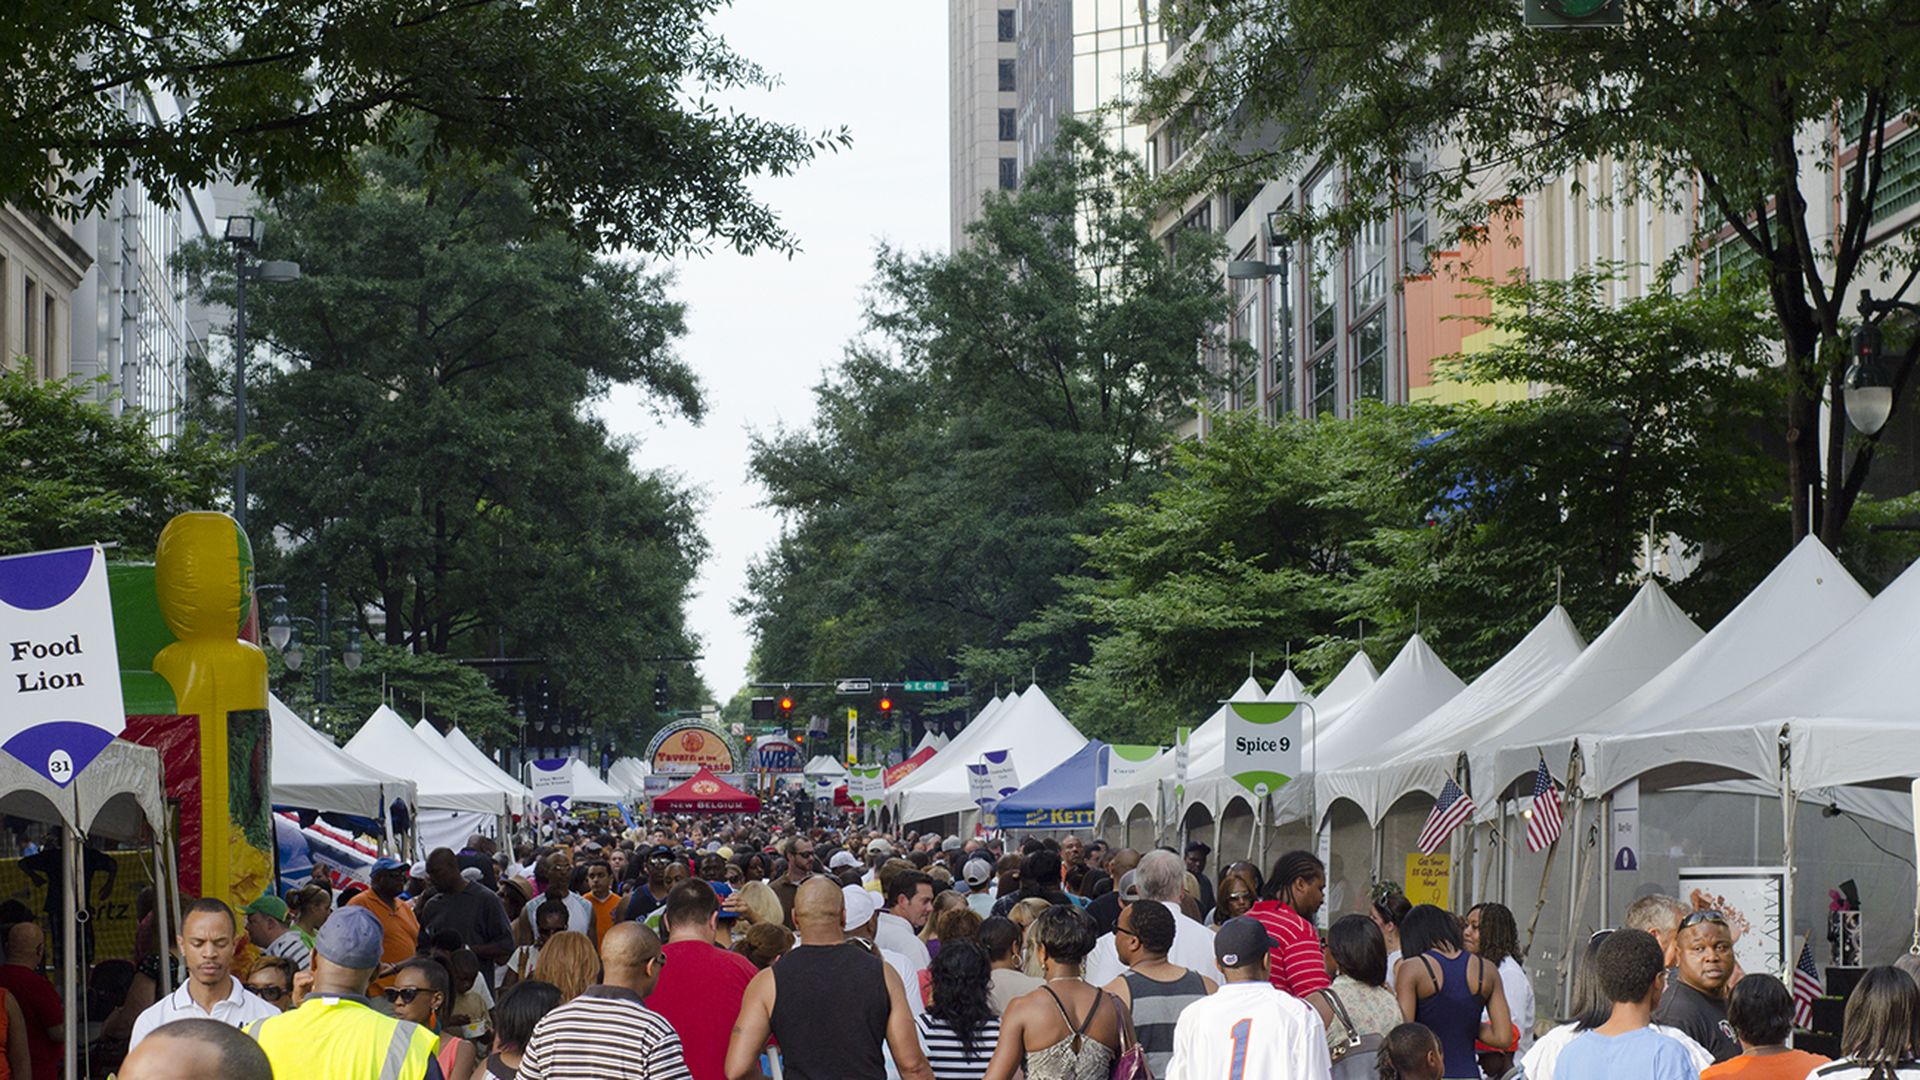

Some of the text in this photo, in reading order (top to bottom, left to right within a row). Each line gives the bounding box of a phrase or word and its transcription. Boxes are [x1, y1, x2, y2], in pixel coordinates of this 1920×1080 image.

[10, 633, 83, 662] Food
[16, 671, 86, 694] Lion
[1235, 736, 1291, 755] Spice 9
[657, 752, 696, 762] Tavern
[759, 751, 797, 768] WBT
[50, 761, 71, 773] 31
[1229, 1017, 1253, 1080] 1
